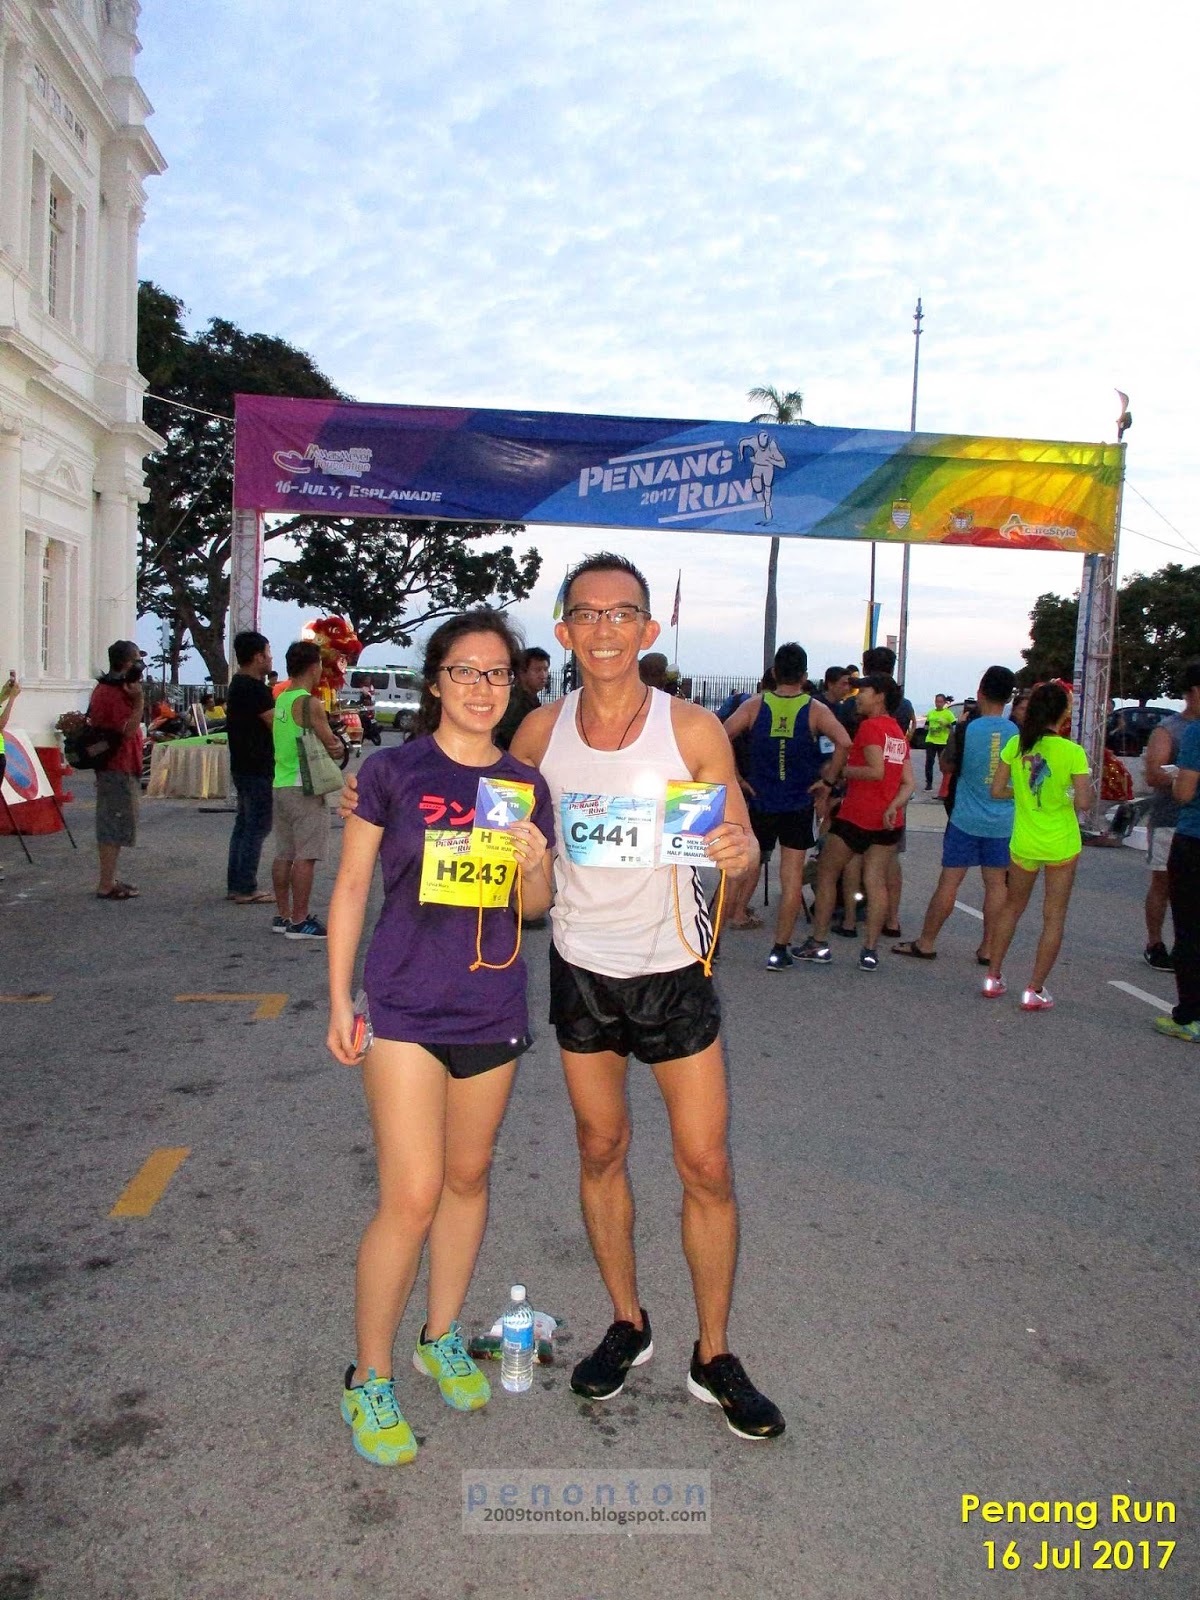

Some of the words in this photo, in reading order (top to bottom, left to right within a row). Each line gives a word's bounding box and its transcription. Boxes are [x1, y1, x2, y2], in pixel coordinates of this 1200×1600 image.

[579, 450, 733, 497] PENANG
[349, 484, 443, 502] ESPLANADE
[641, 487, 677, 506] 2017
[677, 478, 753, 513] RUN
[487, 801, 509, 827] 4
[569, 800, 600, 810] PENANG
[588, 807, 605, 815] RUN
[678, 803, 701, 831] 7
[435, 837, 470, 848] PENANG
[480, 831, 493, 844] H
[571, 821, 638, 848] C441
[671, 836, 683, 849] C
[436, 859, 508, 886] H243
